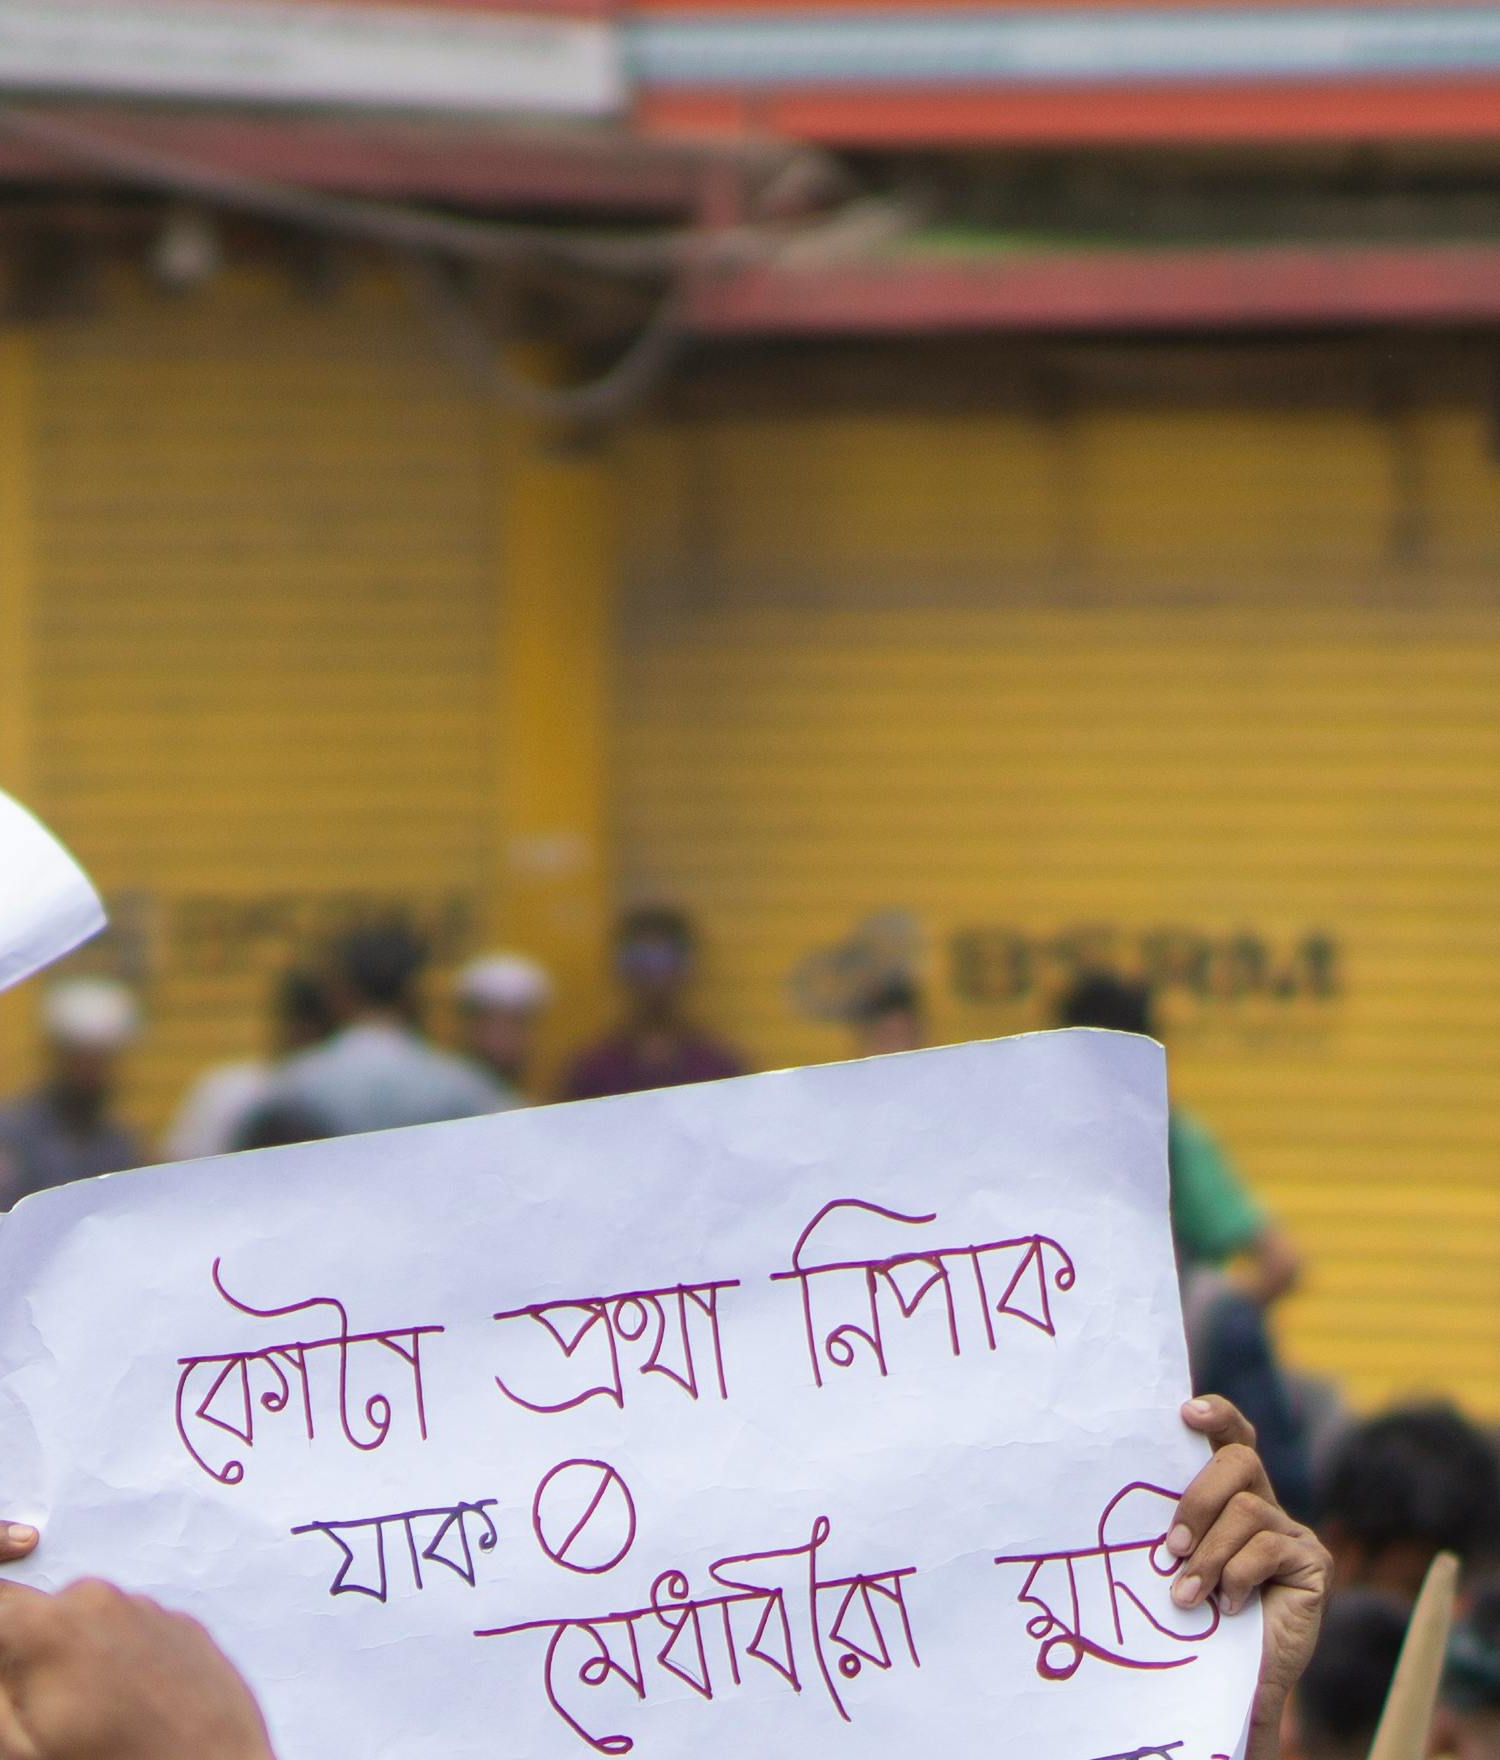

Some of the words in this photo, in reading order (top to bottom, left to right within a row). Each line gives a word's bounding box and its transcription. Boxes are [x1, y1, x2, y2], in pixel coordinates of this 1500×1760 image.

[176, 1257, 446, 1485] কোটা
[493, 1279, 741, 1412] প্রথা
[290, 1498, 499, 1602] যাক
